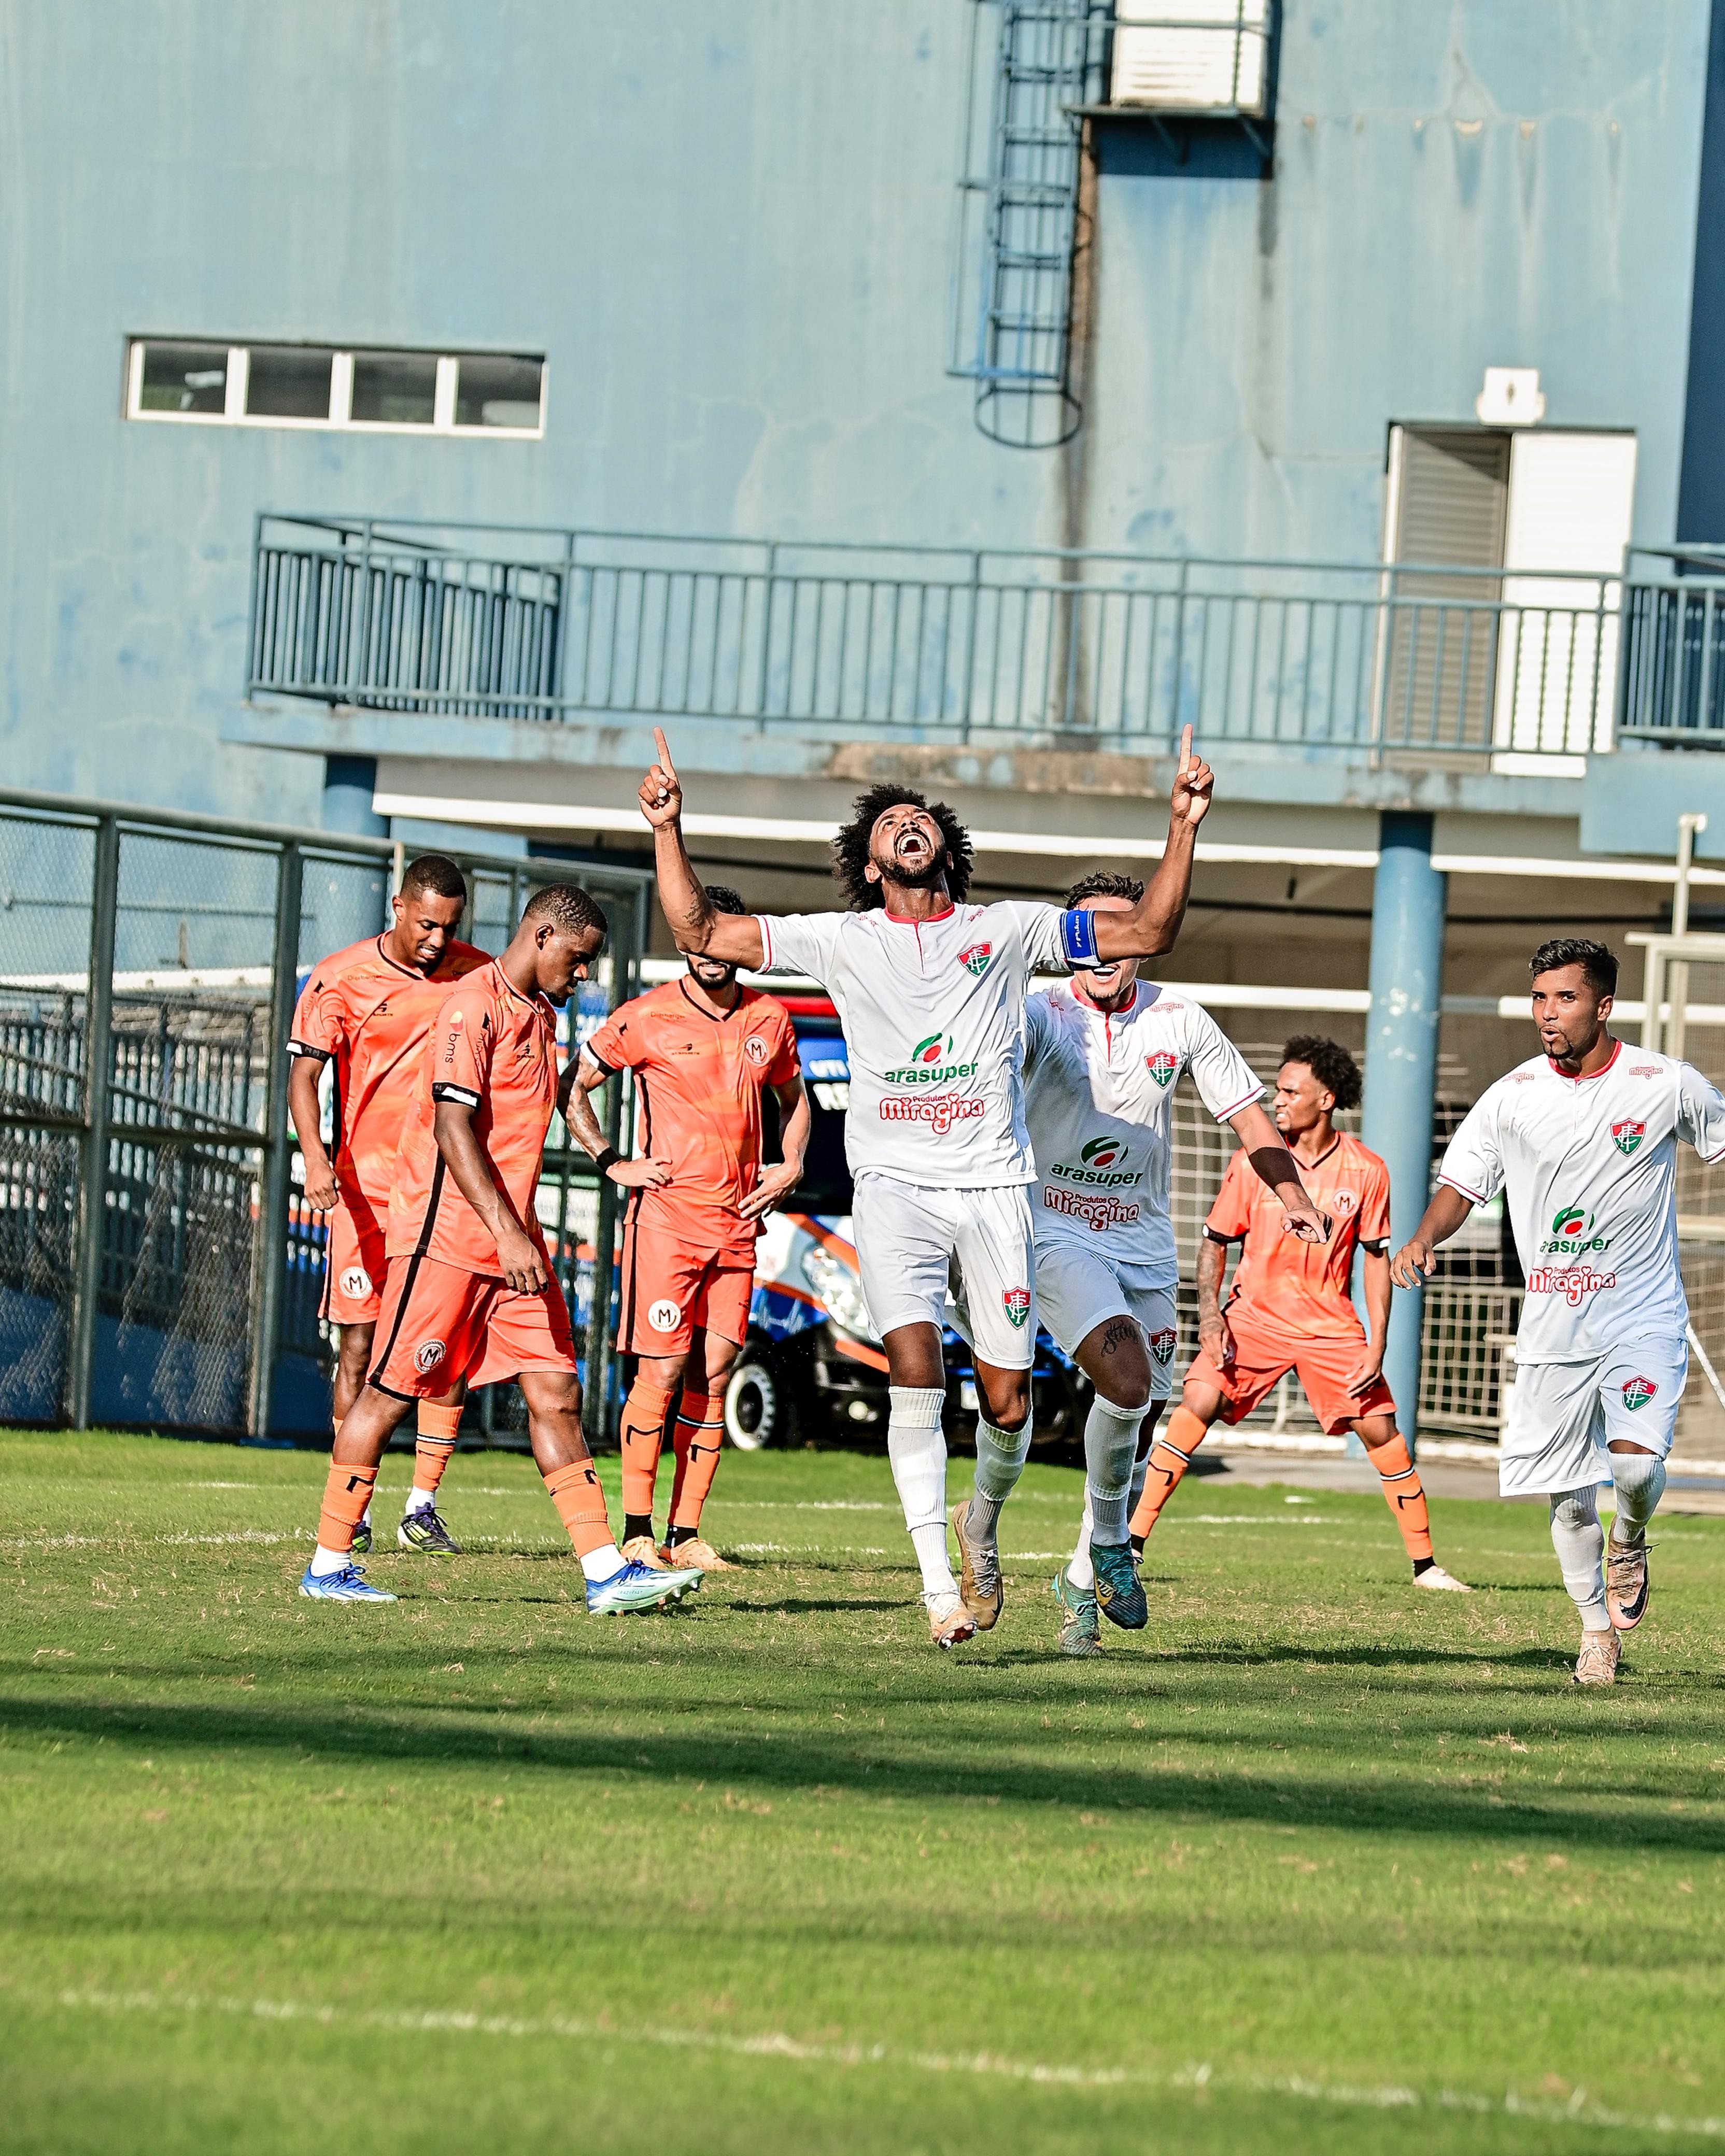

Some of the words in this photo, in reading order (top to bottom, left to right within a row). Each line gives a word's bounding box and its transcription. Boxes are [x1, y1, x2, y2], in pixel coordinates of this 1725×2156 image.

[445, 1033, 461, 1063] bms
[884, 1062, 979, 1083] arasuper
[1051, 1163, 1143, 1187] arasuper
[1074, 1194, 1107, 1203] Produtos
